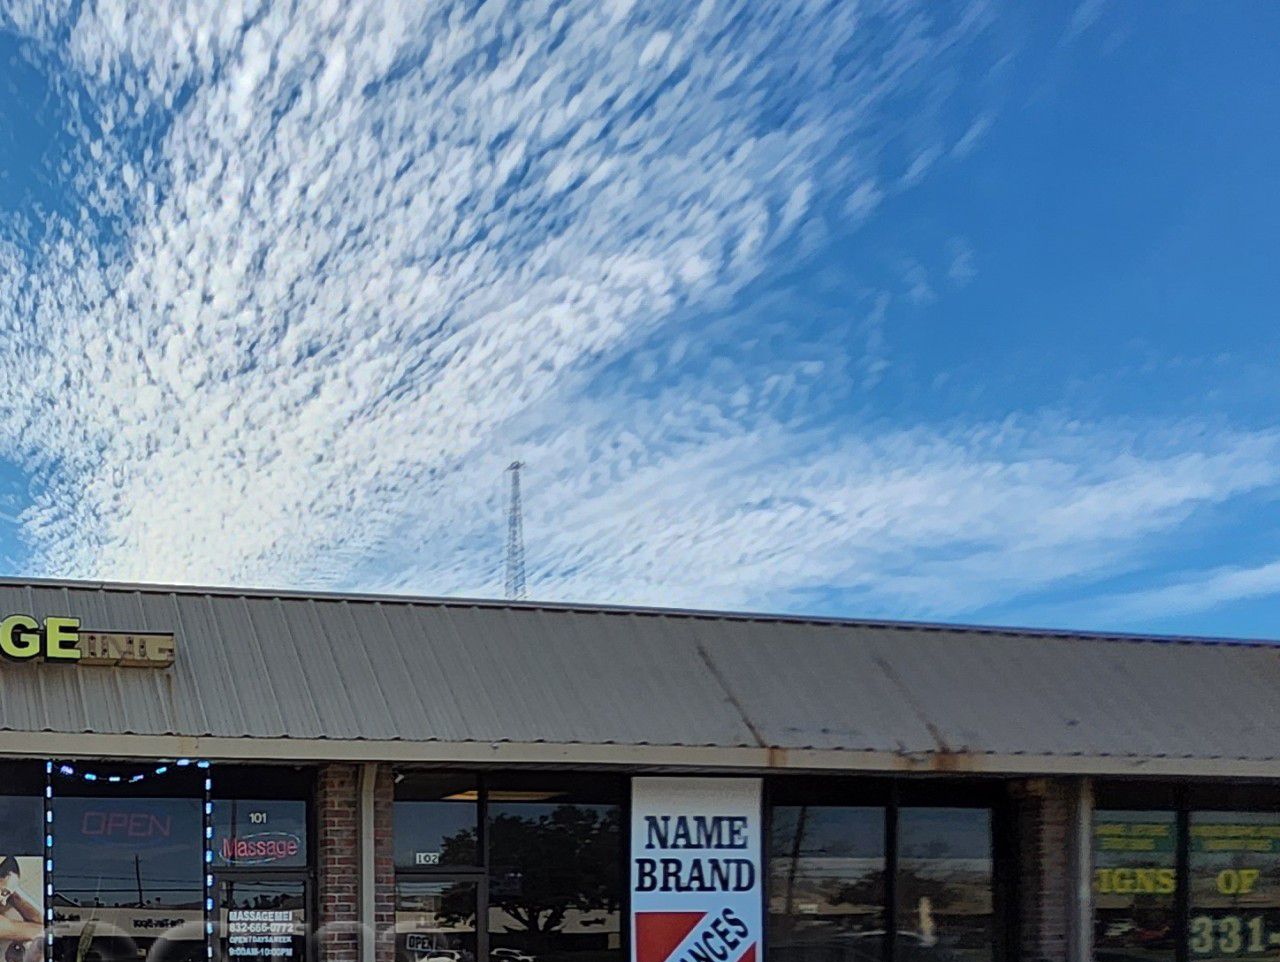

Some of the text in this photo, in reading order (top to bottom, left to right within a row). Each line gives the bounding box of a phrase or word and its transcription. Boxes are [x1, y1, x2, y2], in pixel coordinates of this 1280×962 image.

[81, 811, 171, 836] OPEN
[249, 813, 266, 824] 101
[644, 815, 748, 849] NAME
[223, 838, 297, 858] Massage
[634, 858, 756, 892] BRAND
[1095, 868, 1260, 894] IGNS OF
